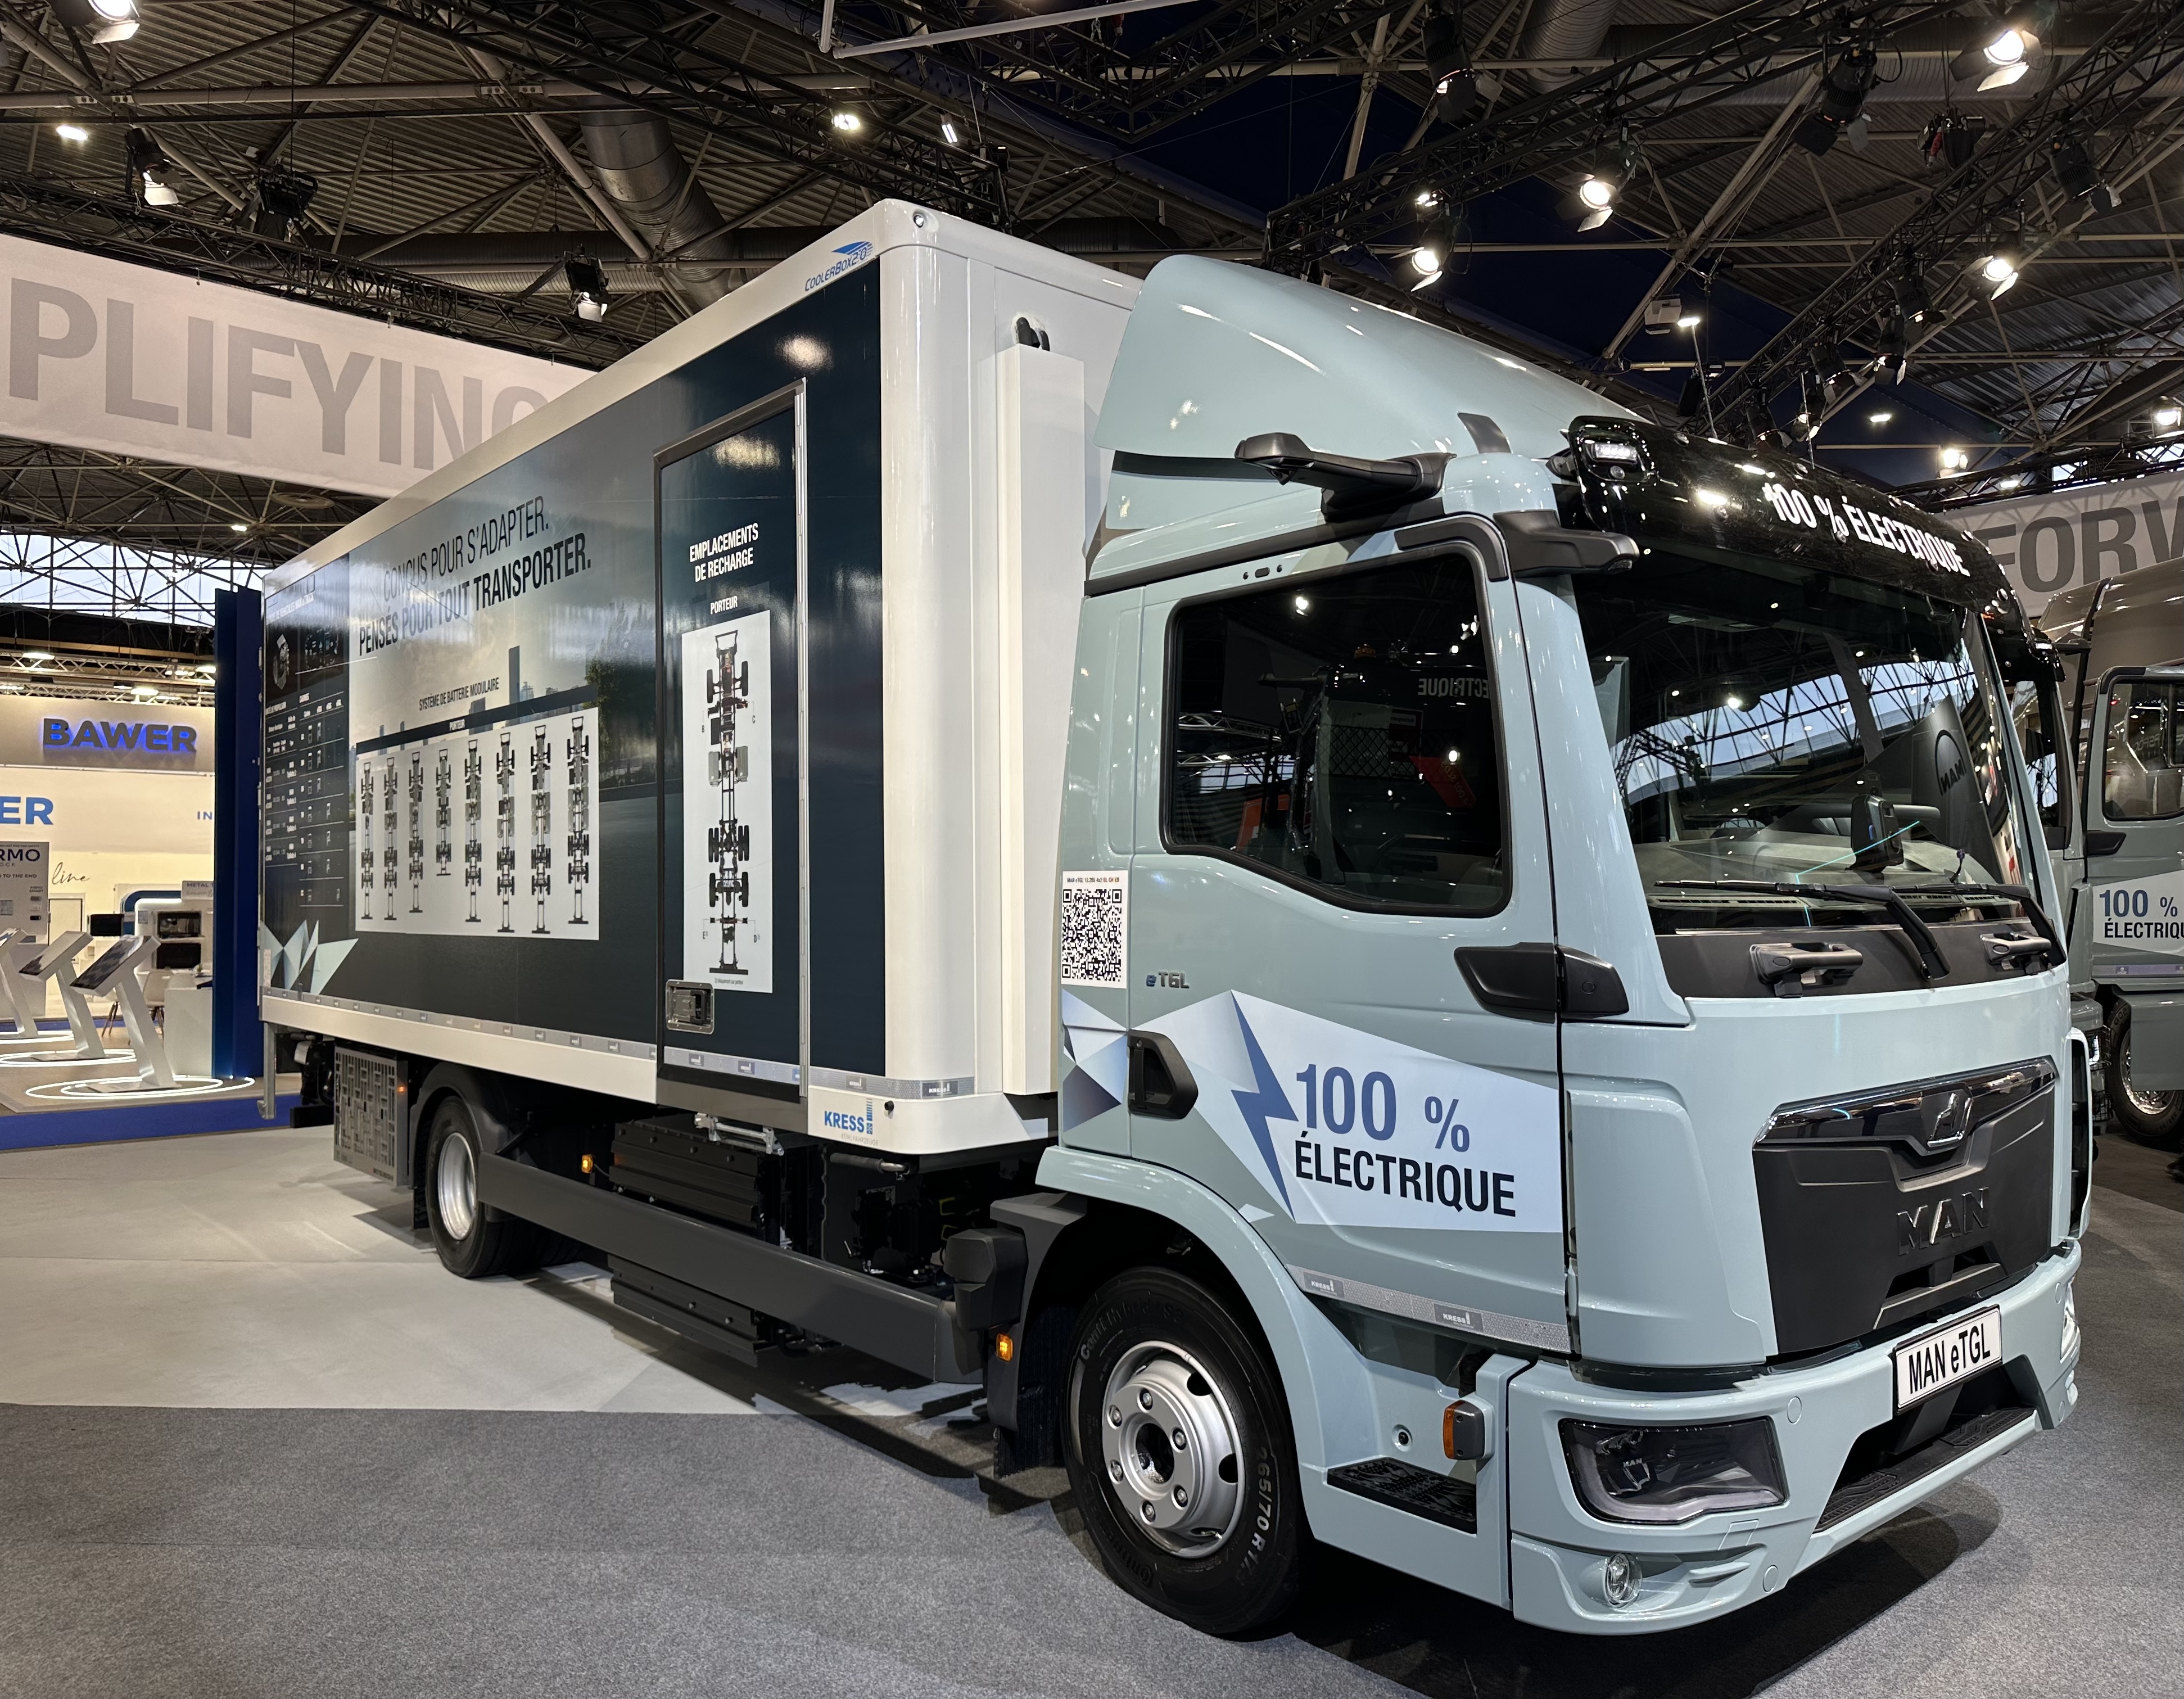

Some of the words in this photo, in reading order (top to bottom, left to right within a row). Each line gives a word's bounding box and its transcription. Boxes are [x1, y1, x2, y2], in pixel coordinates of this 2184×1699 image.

[689, 522, 759, 563] EMPLACEMENTS
[1814, 494, 1850, 536] %
[1842, 495, 1970, 577] ÉLECTRIQUE
[431, 535, 463, 581] POUR
[695, 564, 707, 582] DE
[708, 547, 754, 578] RECHARGE
[360, 606, 398, 656] PENSÉS
[402, 599, 433, 640] POUR
[438, 581, 470, 625] TOUT
[474, 532, 591, 611] TRANSPORTER.
[710, 595, 738, 614] PORTEUR
[440, 692, 446, 704] DE
[447, 685, 469, 703] BATTERIE
[470, 677, 499, 697] MODULAIRE
[43, 718, 197, 752] BAWER
[752, 715, 756, 724] C
[0, 796, 54, 825] ER
[52, 862, 91, 885] line
[2099, 889, 2148, 917] 100
[2160, 897, 2178, 917] %
[1146, 971, 1190, 988] eTGL
[824, 1110, 864, 1133] KRESS
[1296, 1063, 1397, 1141] 100
[1425, 1096, 1470, 1153] %
[1295, 1131, 1516, 1218] ÉLECTRIQUE
[1896, 1186, 1989, 1255] MAN
[1311, 1280, 1330, 1291] KRESS
[1443, 1313, 1466, 1323] KRESS
[1909, 1340, 1945, 1394] MAN
[1951, 1322, 1991, 1373] eTGL
